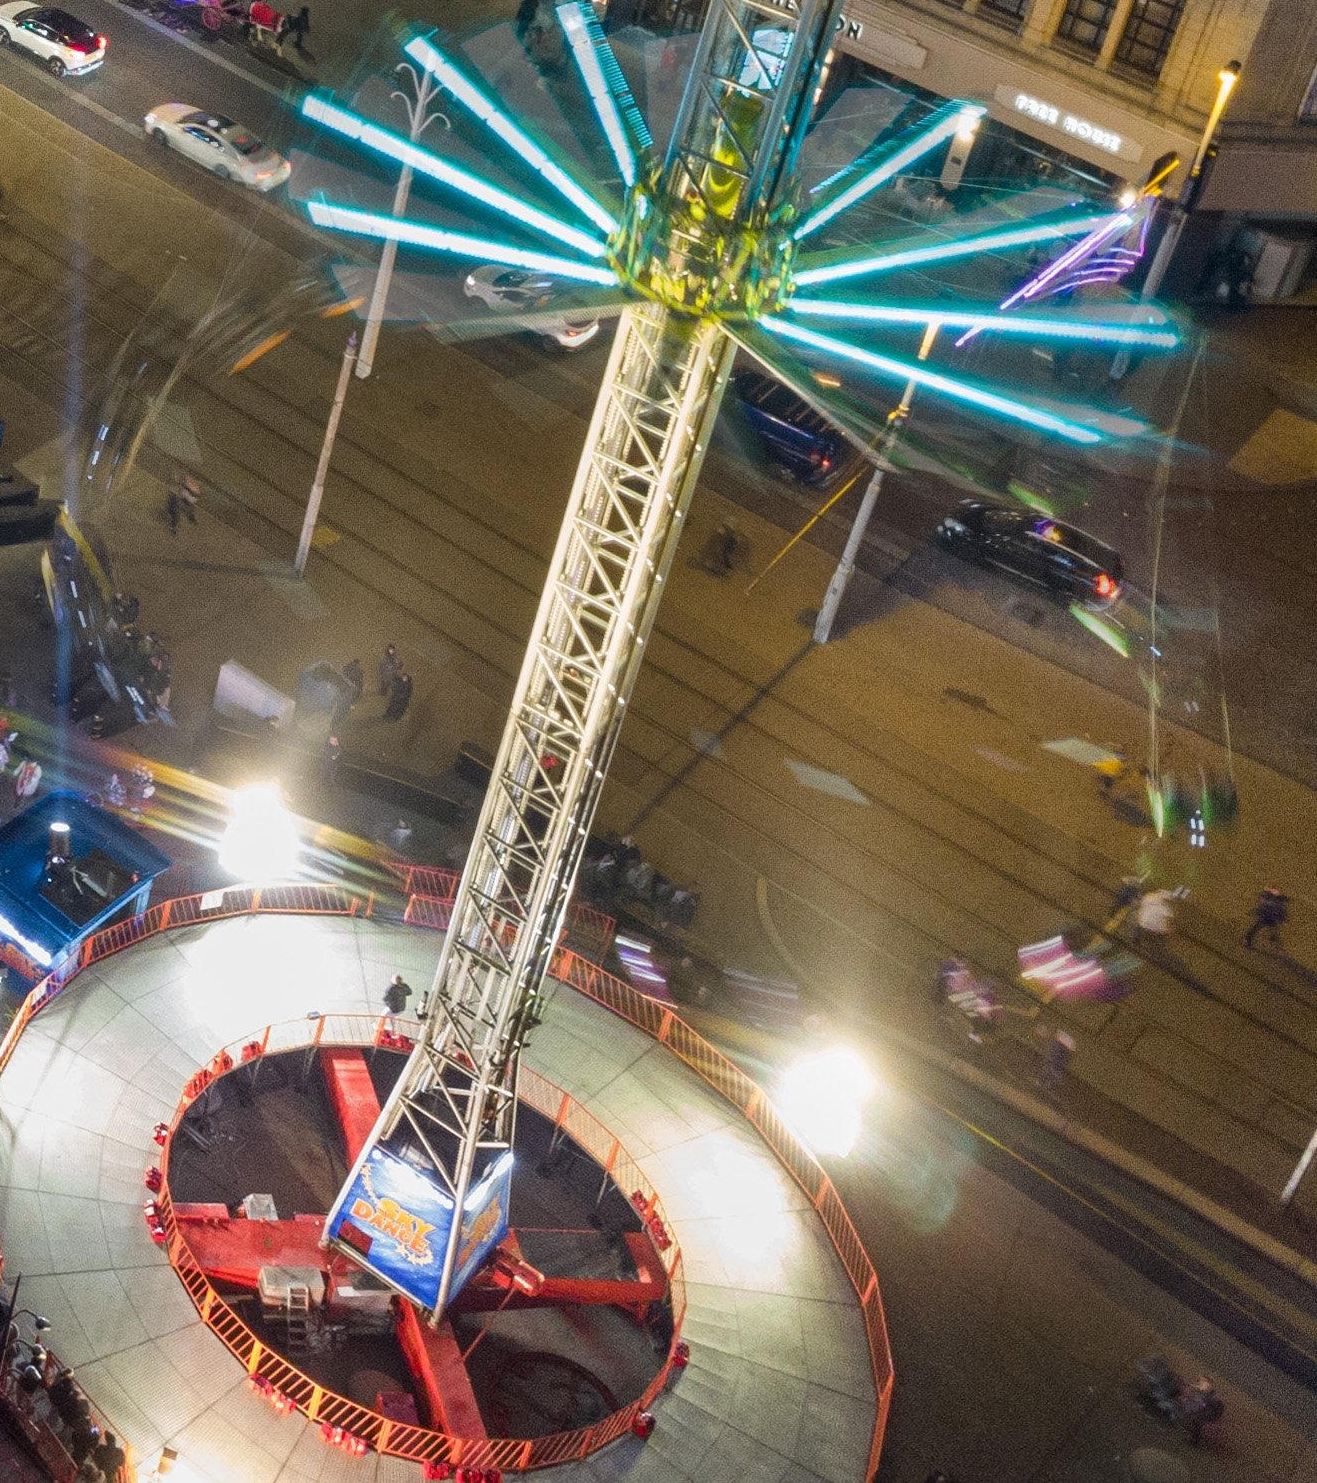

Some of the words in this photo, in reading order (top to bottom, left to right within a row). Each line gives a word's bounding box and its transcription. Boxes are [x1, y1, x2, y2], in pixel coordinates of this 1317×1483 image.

[1014, 92, 1060, 125] FREE
[1062, 114, 1122, 153] HOUSE
[350, 1198, 429, 1255] DANCE
[378, 1196, 436, 1238] SKY
